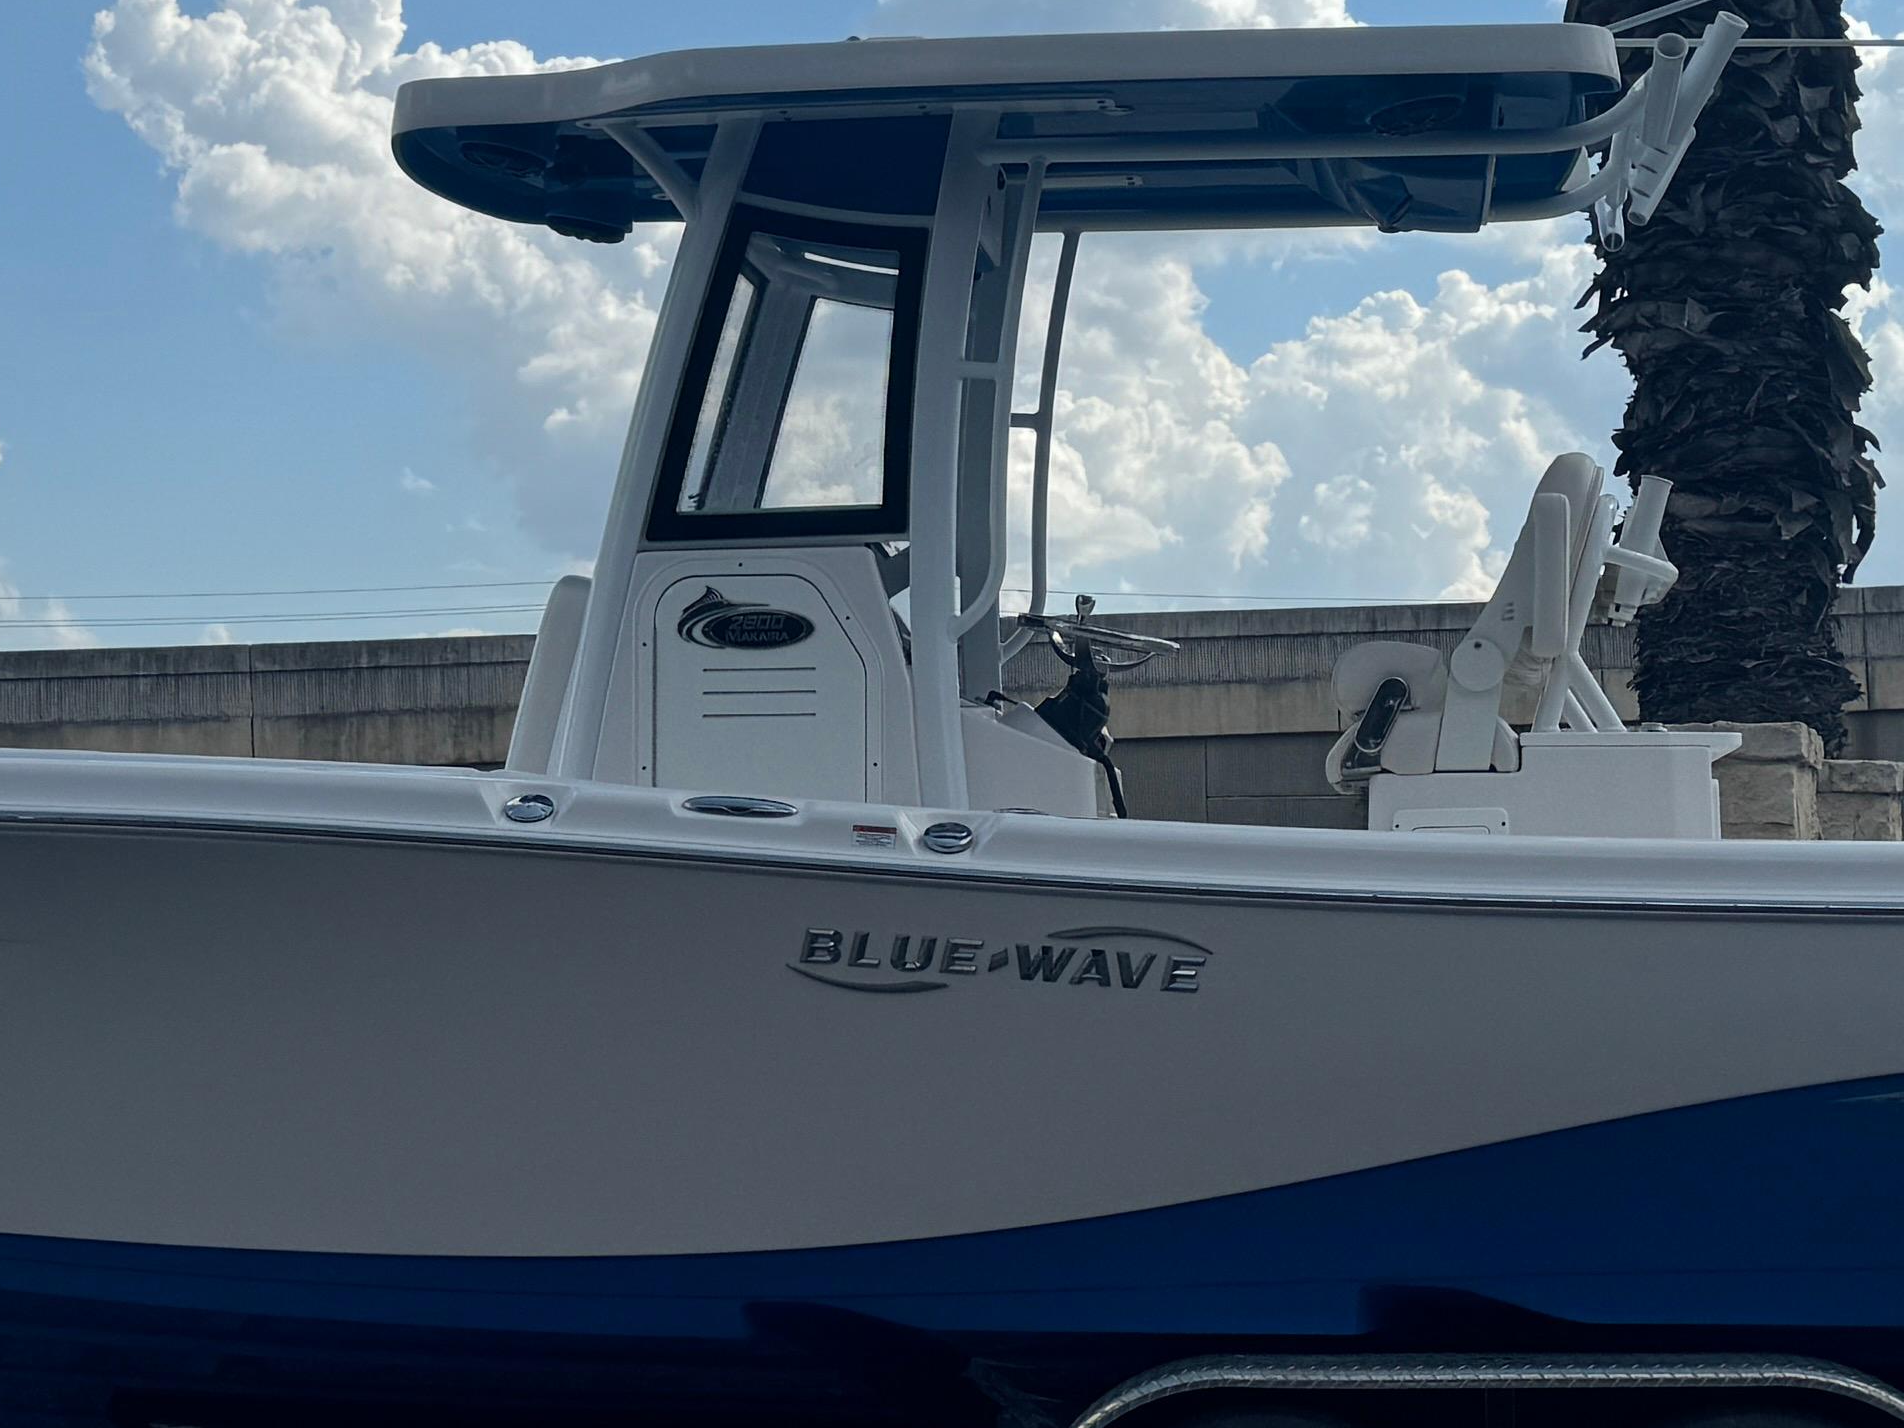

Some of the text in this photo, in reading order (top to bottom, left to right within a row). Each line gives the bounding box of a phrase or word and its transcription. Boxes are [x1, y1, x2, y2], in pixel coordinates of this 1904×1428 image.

[729, 615, 786, 630] 2800
[800, 926, 1207, 993] BLUE WAVE
